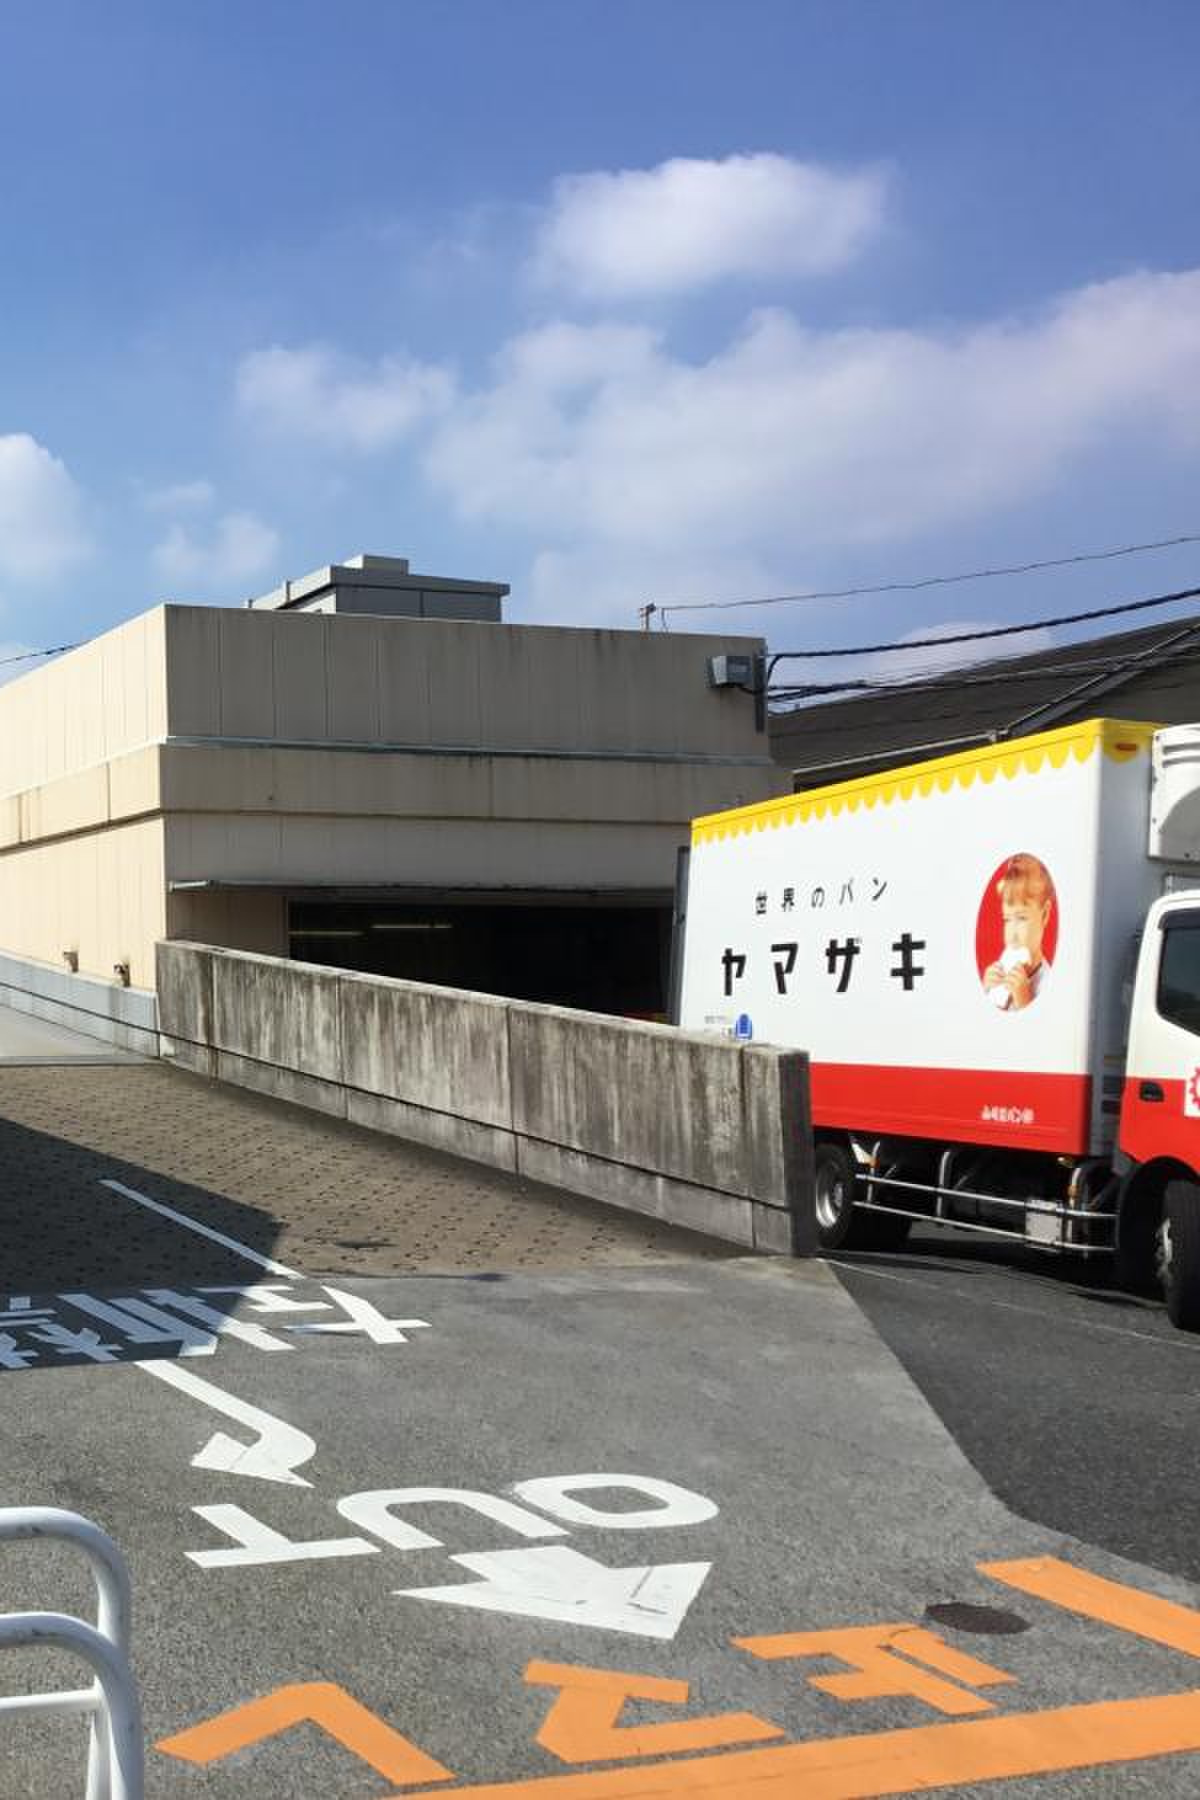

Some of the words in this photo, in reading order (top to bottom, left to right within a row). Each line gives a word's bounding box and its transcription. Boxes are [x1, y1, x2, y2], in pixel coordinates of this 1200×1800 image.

[721, 933, 926, 996] ヤマザキ
[184, 1472, 719, 1568] OUT
[154, 1622, 1020, 1786] 止マレ
